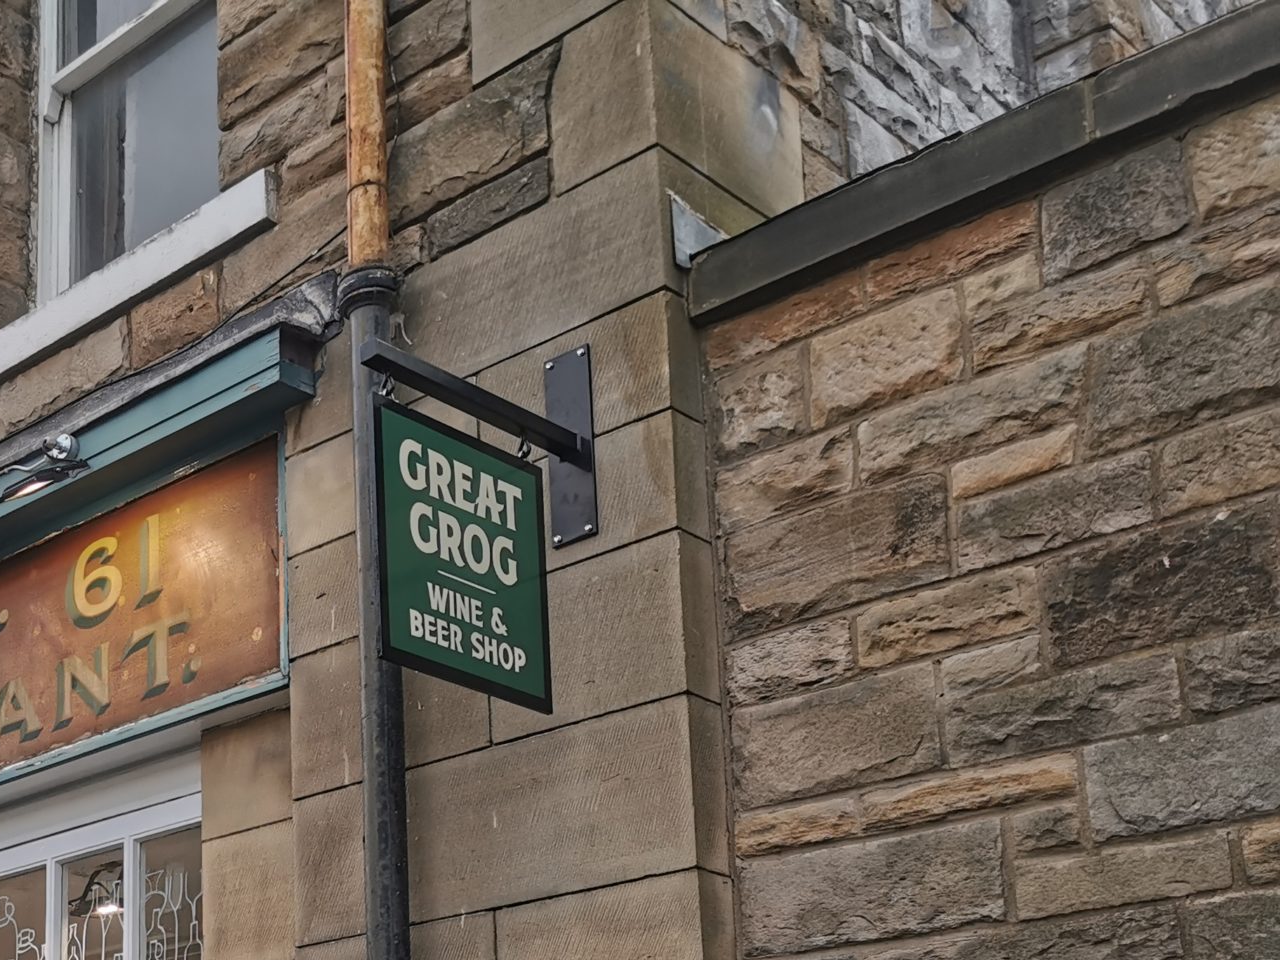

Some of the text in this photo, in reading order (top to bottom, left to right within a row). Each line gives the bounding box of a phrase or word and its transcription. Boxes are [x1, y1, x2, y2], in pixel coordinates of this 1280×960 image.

[399, 438, 522, 532] GREAT
[68, 512, 164, 630] 61
[409, 502, 518, 586] GROG
[409, 608, 526, 673] BEER SHOP
[426, 581, 508, 636] WINE &
